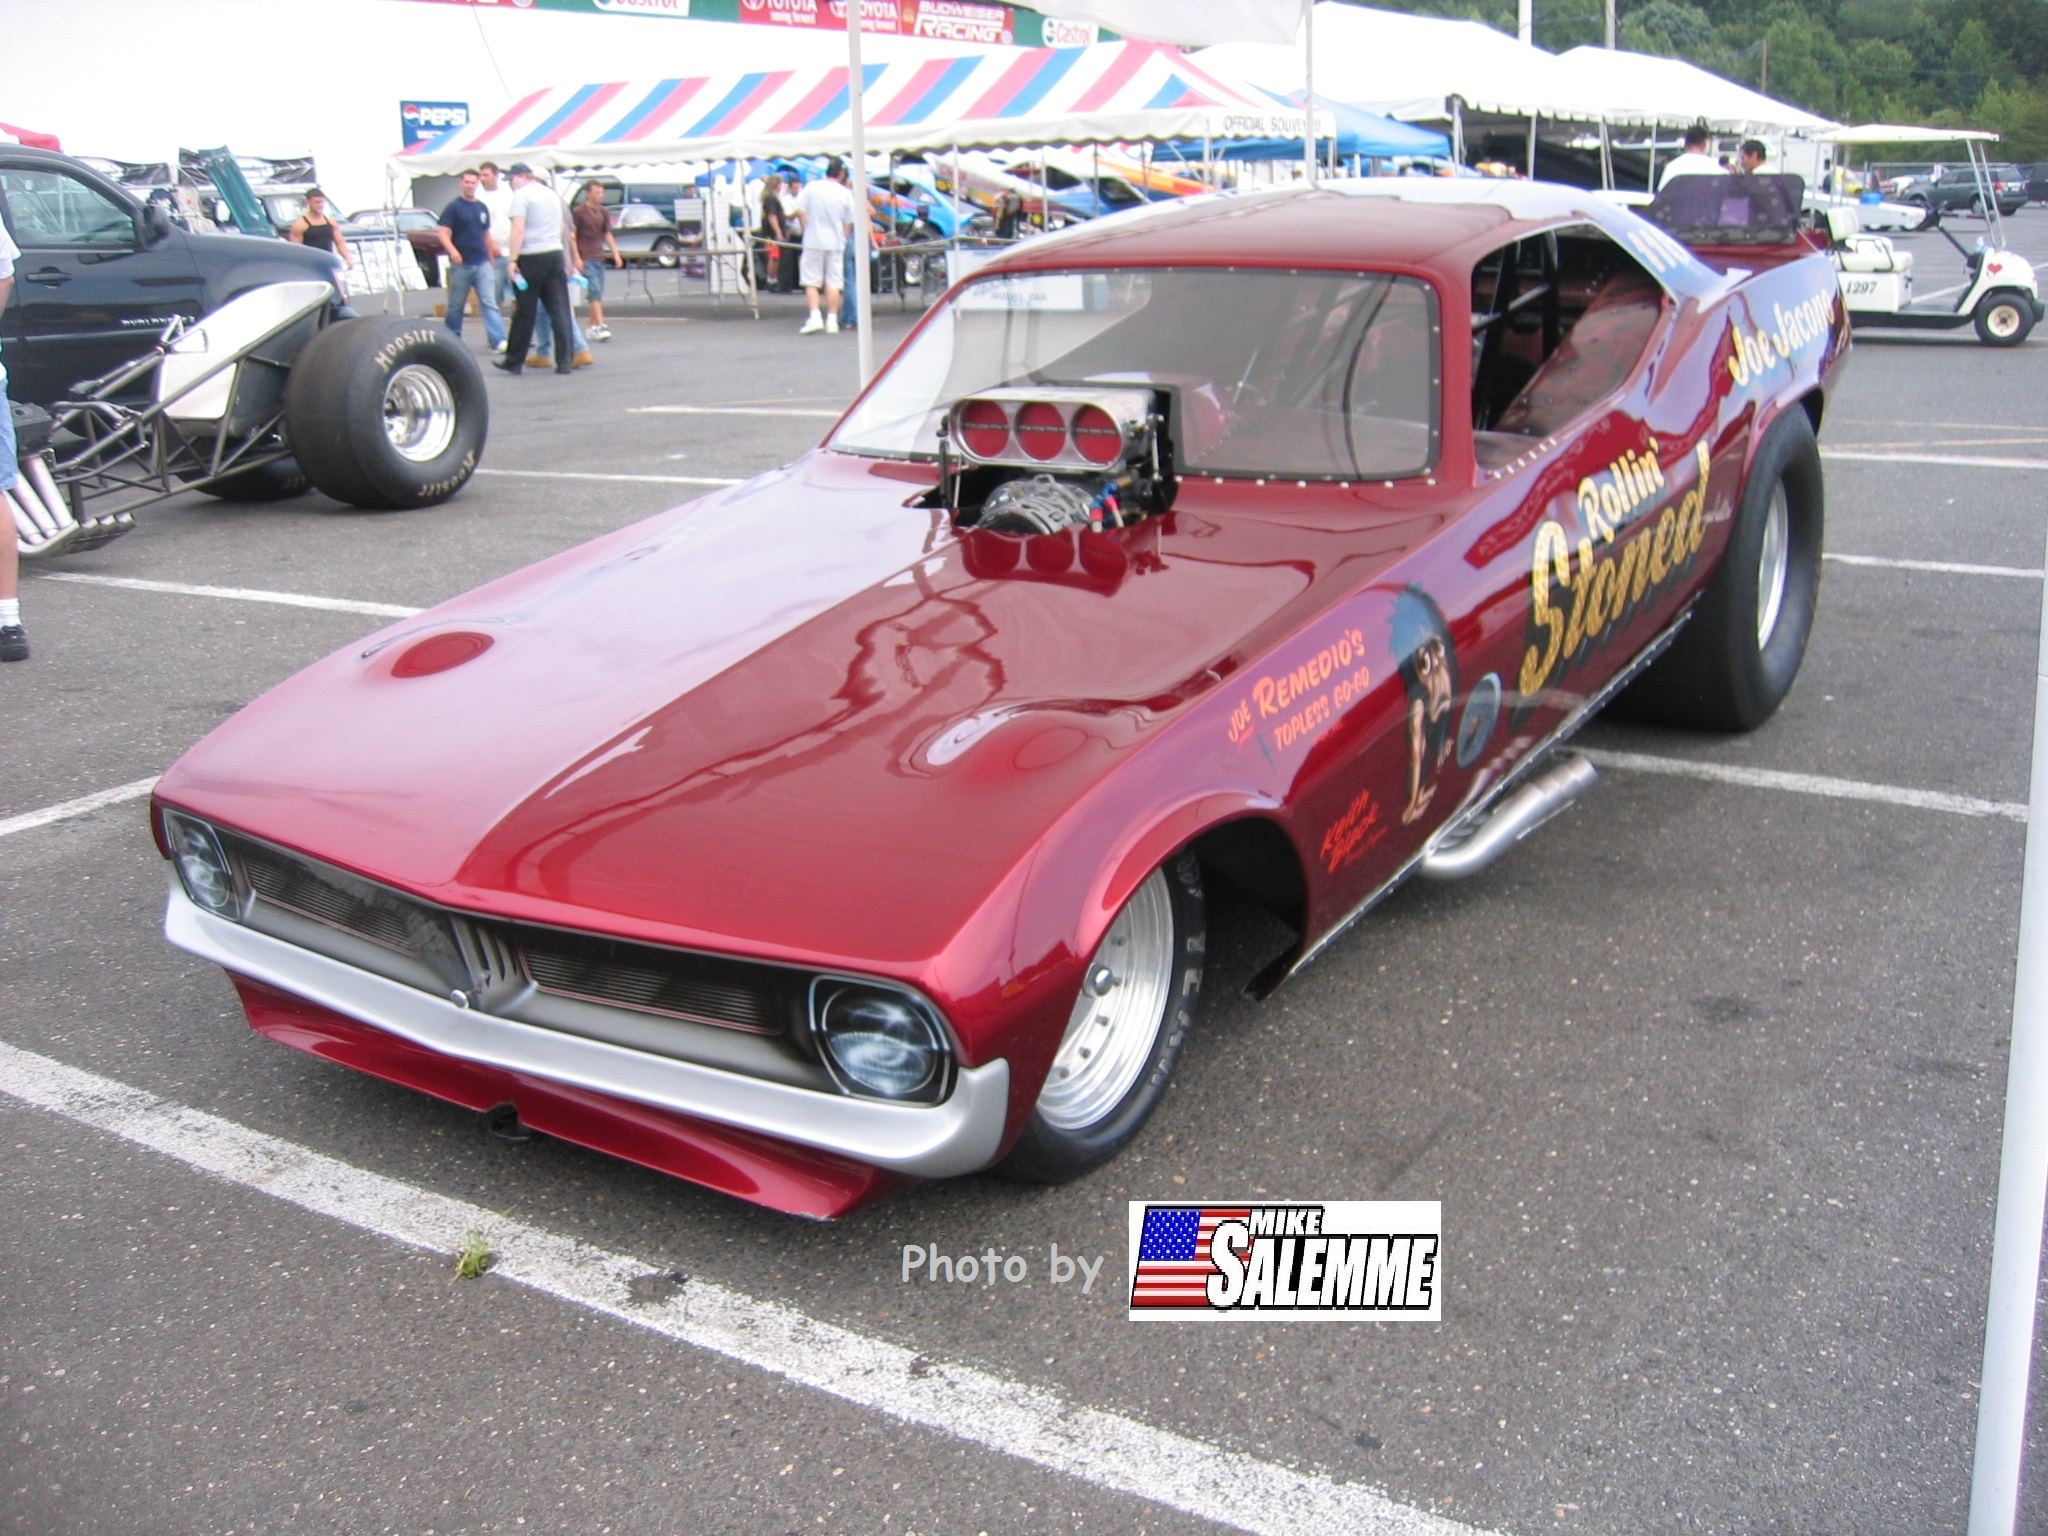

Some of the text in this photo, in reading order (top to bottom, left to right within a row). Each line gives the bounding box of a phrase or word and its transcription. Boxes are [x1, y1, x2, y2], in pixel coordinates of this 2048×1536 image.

[767, 0, 818, 12] TOYOTA
[859, 1, 898, 19] OYOTA
[919, 0, 1005, 19] BUDWEISER
[913, 13, 1003, 42] RACING
[1056, 22, 1092, 46] Castrol
[420, 107, 466, 126] PEPSI
[1224, 115, 1265, 132] OFFICIAL
[1846, 280, 1877, 296] 1297
[121, 315, 196, 326] AVALANHE
[1728, 326, 1776, 386] Joe
[1577, 436, 1665, 543] Rollin'
[1519, 440, 1710, 697] Stoned
[1274, 695, 1331, 751] TOPLESS
[1333, 666, 1370, 708] GO-GO
[1228, 698, 1252, 743] JOE
